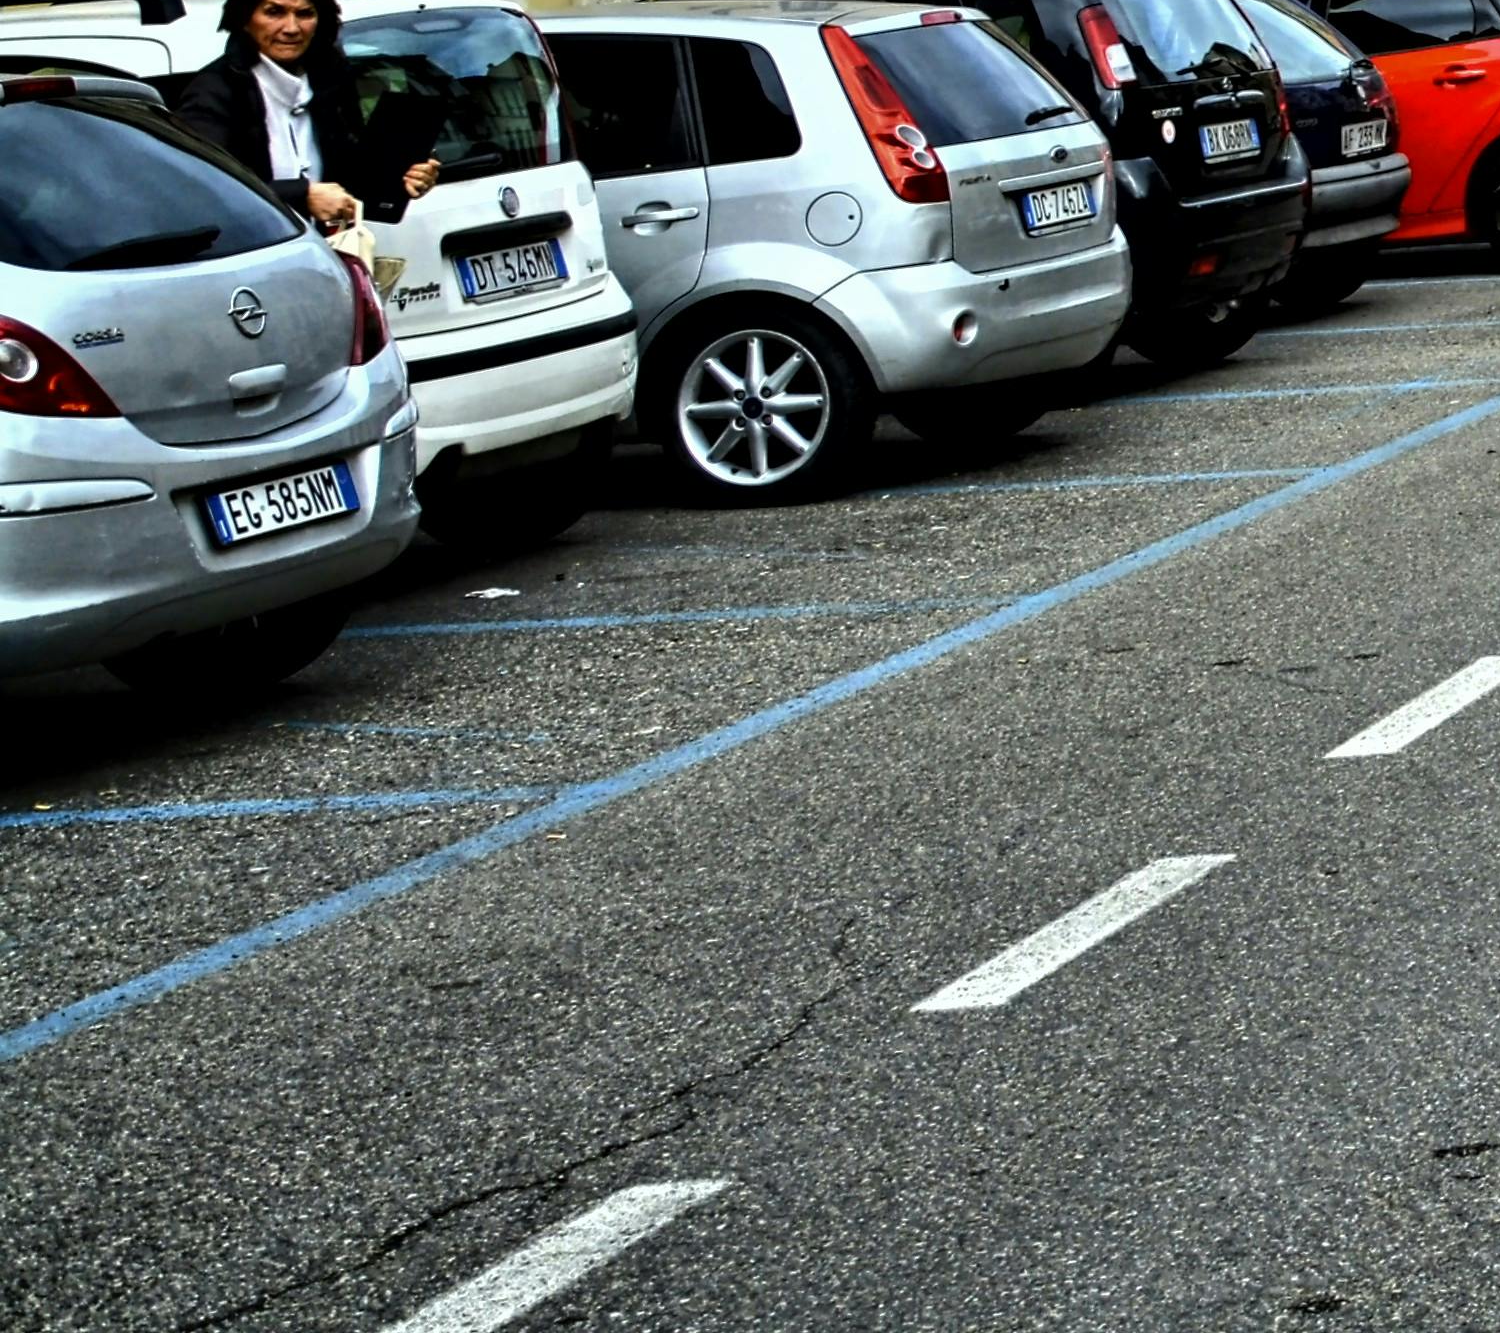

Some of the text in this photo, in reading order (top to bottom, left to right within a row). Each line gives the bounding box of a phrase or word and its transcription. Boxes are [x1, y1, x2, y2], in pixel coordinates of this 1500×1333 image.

[1032, 193, 1050, 223] DC
[471, 256, 497, 291] DT
[225, 469, 343, 534] EG 585NM
